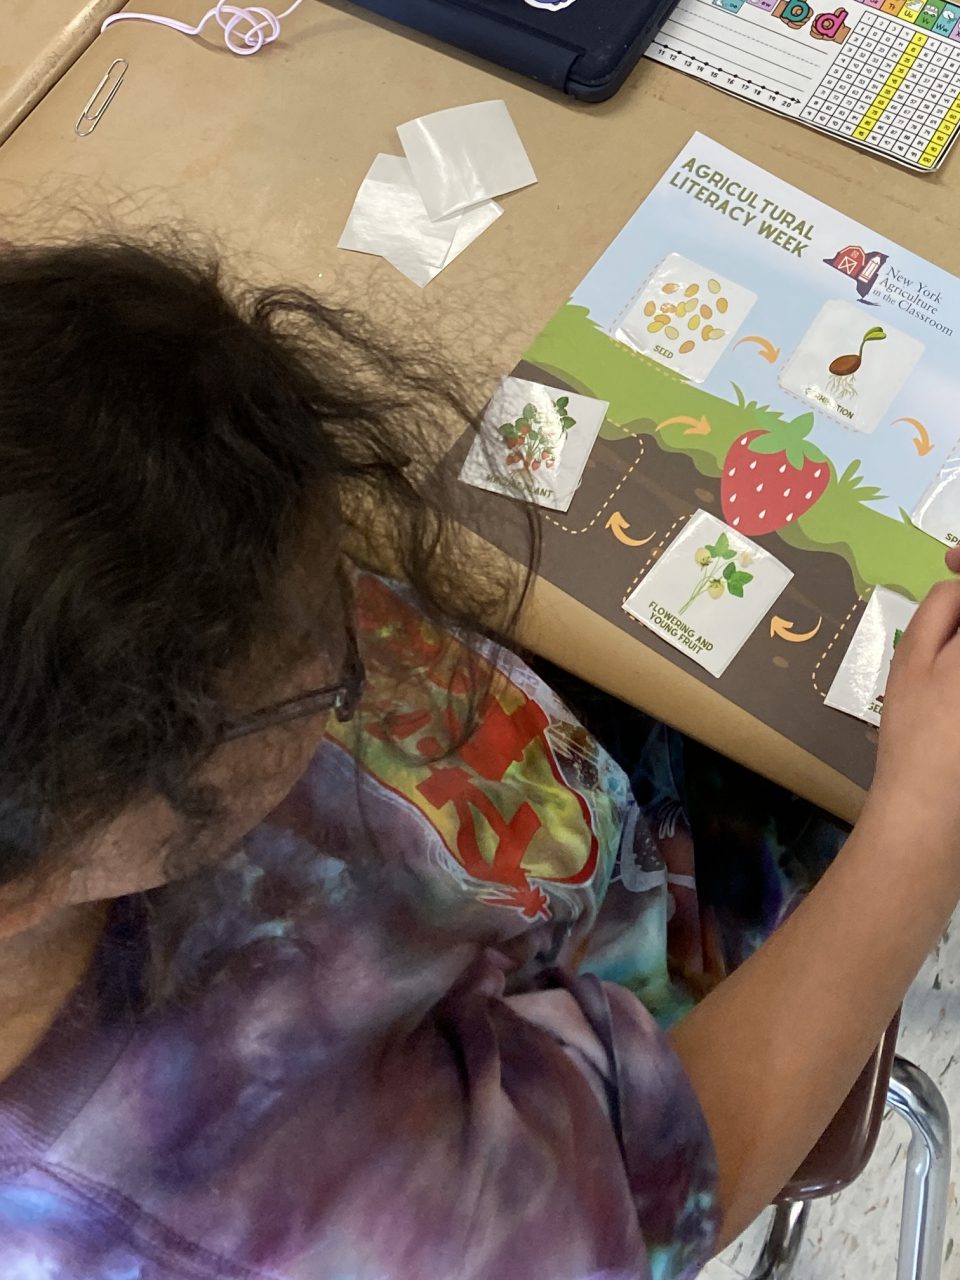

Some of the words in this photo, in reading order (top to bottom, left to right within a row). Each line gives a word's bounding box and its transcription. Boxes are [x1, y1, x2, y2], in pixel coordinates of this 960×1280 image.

[668, 172, 757, 227] LITERACY
[757, 221, 810, 258] WEEK
[681, 157, 815, 241] AGRICULTURAL
[879, 277, 938, 316] Agriculture
[886, 266, 914, 289] New
[917, 282, 943, 304] York
[882, 292, 896, 305] the
[898, 300, 953, 337] Classroom
[653, 345, 674, 359] SEED
[649, 601, 695, 638] FLOWERING
[696, 636, 713, 651] AND
[649, 612, 678, 636] YOUNG
[678, 634, 703, 654] FRUIT
